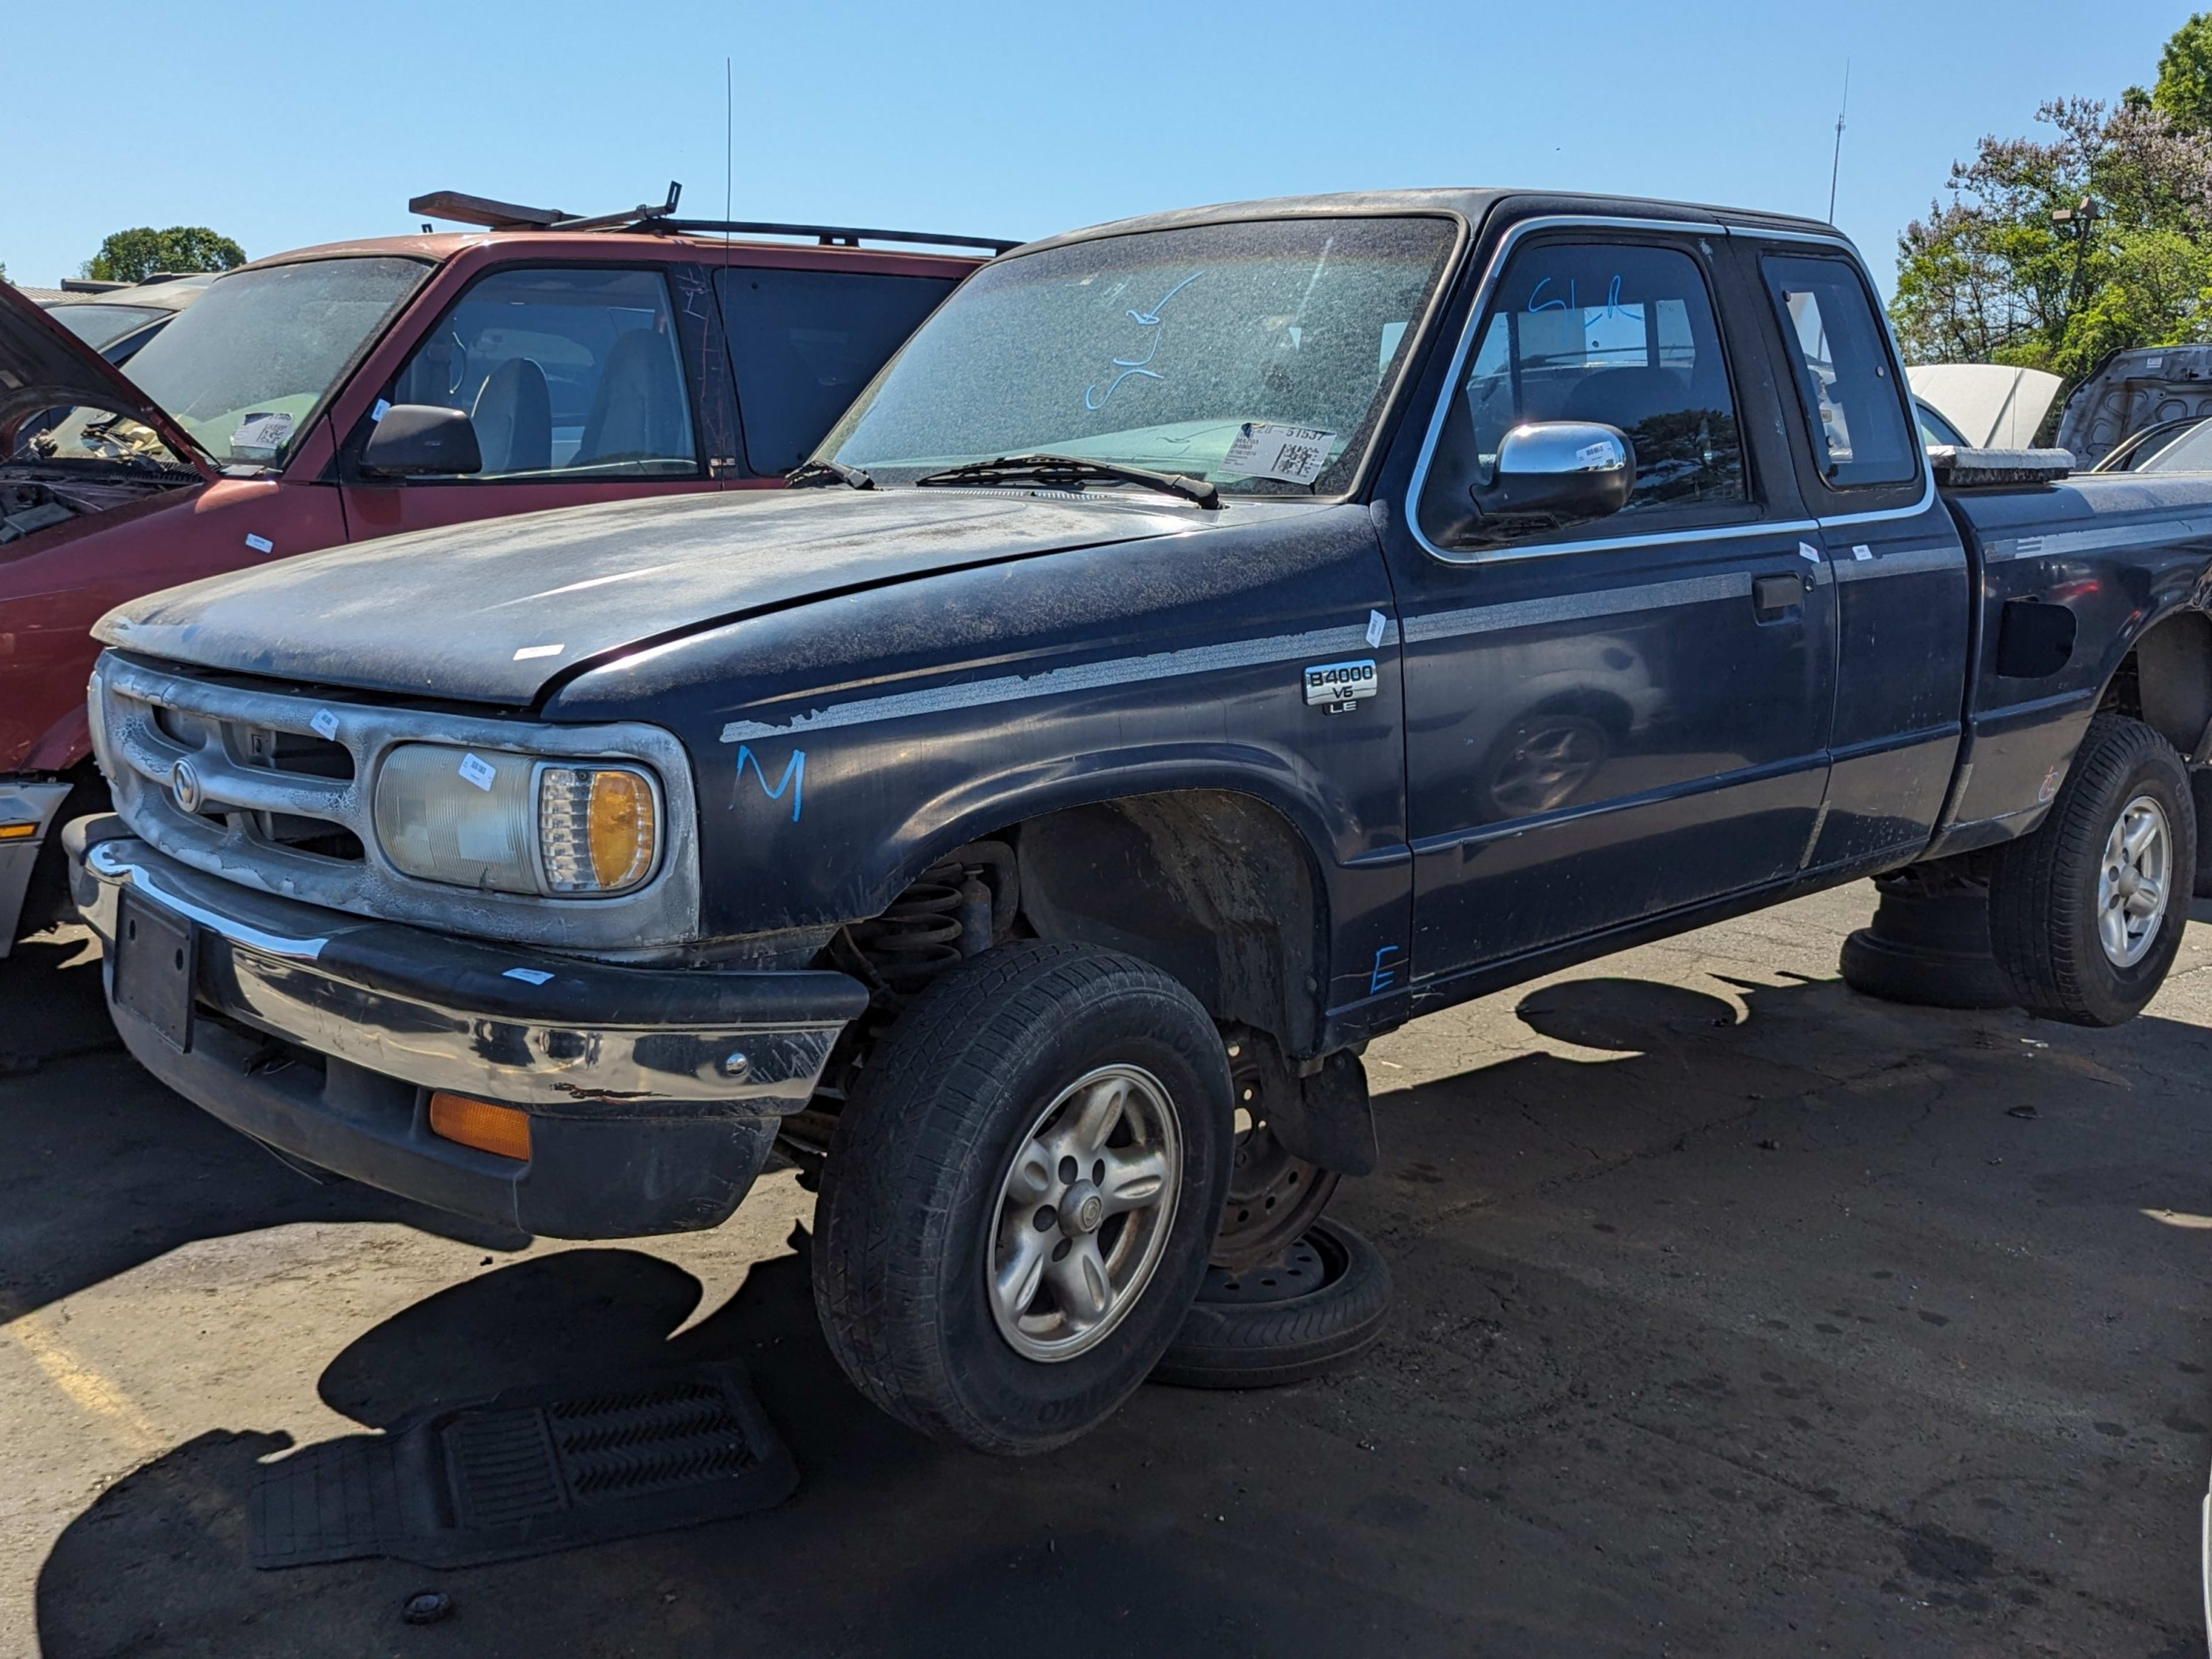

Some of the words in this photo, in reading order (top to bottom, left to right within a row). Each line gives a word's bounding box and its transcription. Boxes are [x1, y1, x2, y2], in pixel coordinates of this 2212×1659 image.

[1309, 665, 1373, 687] B4000
[1332, 685, 1353, 699] V6
[1330, 700, 1357, 714] LE
[728, 745, 806, 822] M
[1370, 946, 1399, 995] E
